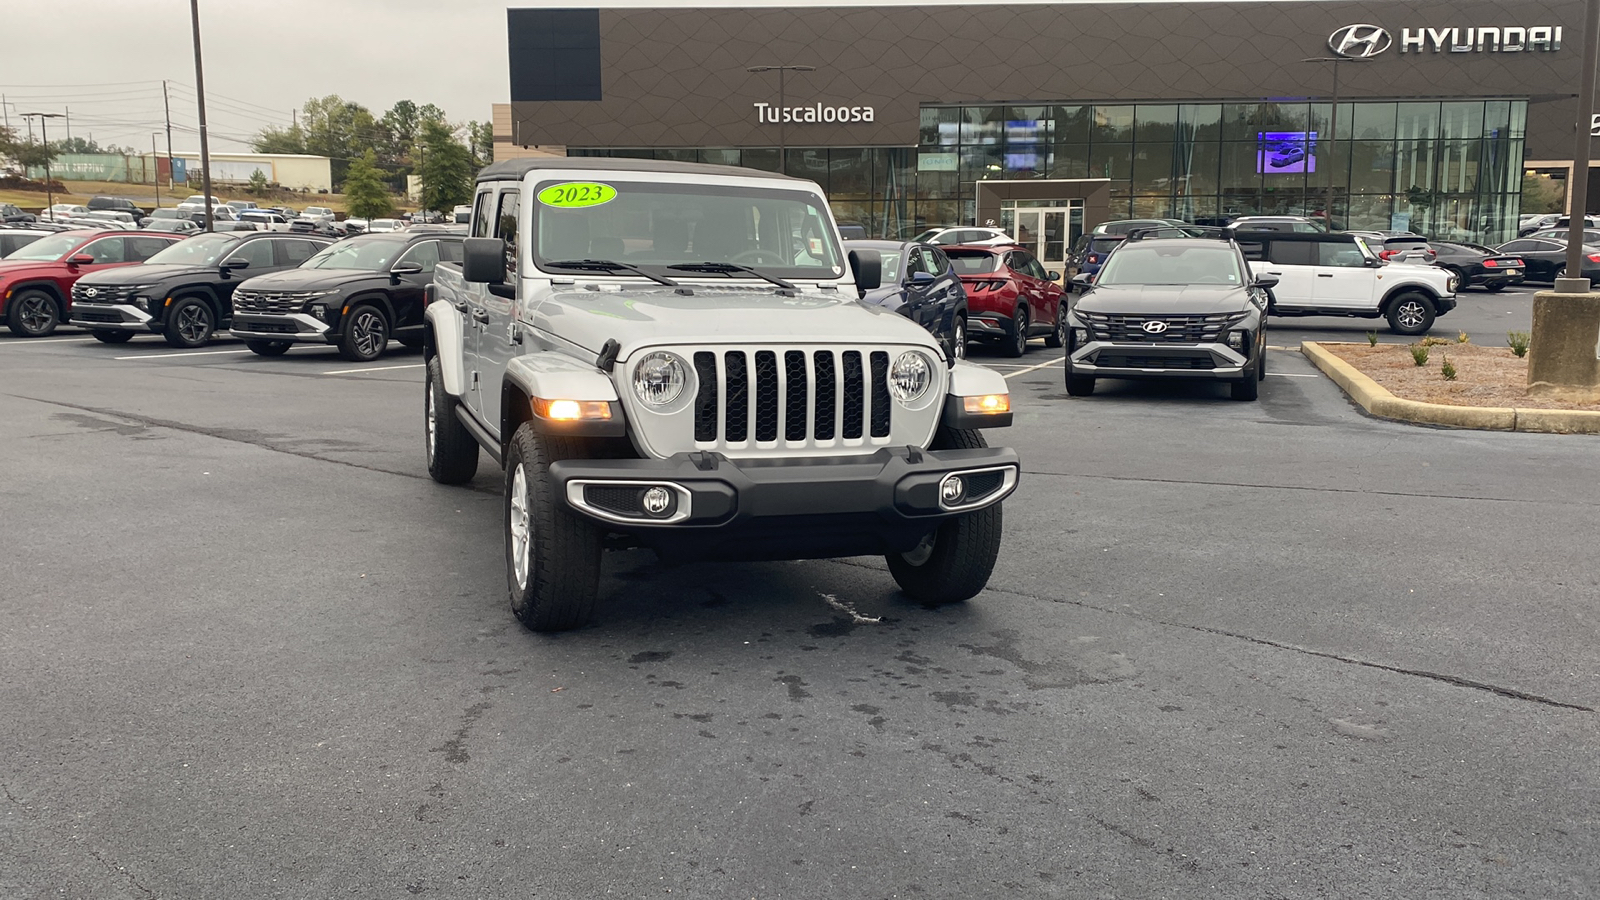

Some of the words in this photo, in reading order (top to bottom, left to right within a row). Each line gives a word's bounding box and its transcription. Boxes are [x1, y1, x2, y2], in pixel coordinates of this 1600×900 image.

[1400, 26, 1562, 53] HYUNDAI
[753, 102, 874, 123] Tuscaloosa
[72, 163, 104, 173] SHIPPING
[552, 186, 603, 203] 2023
